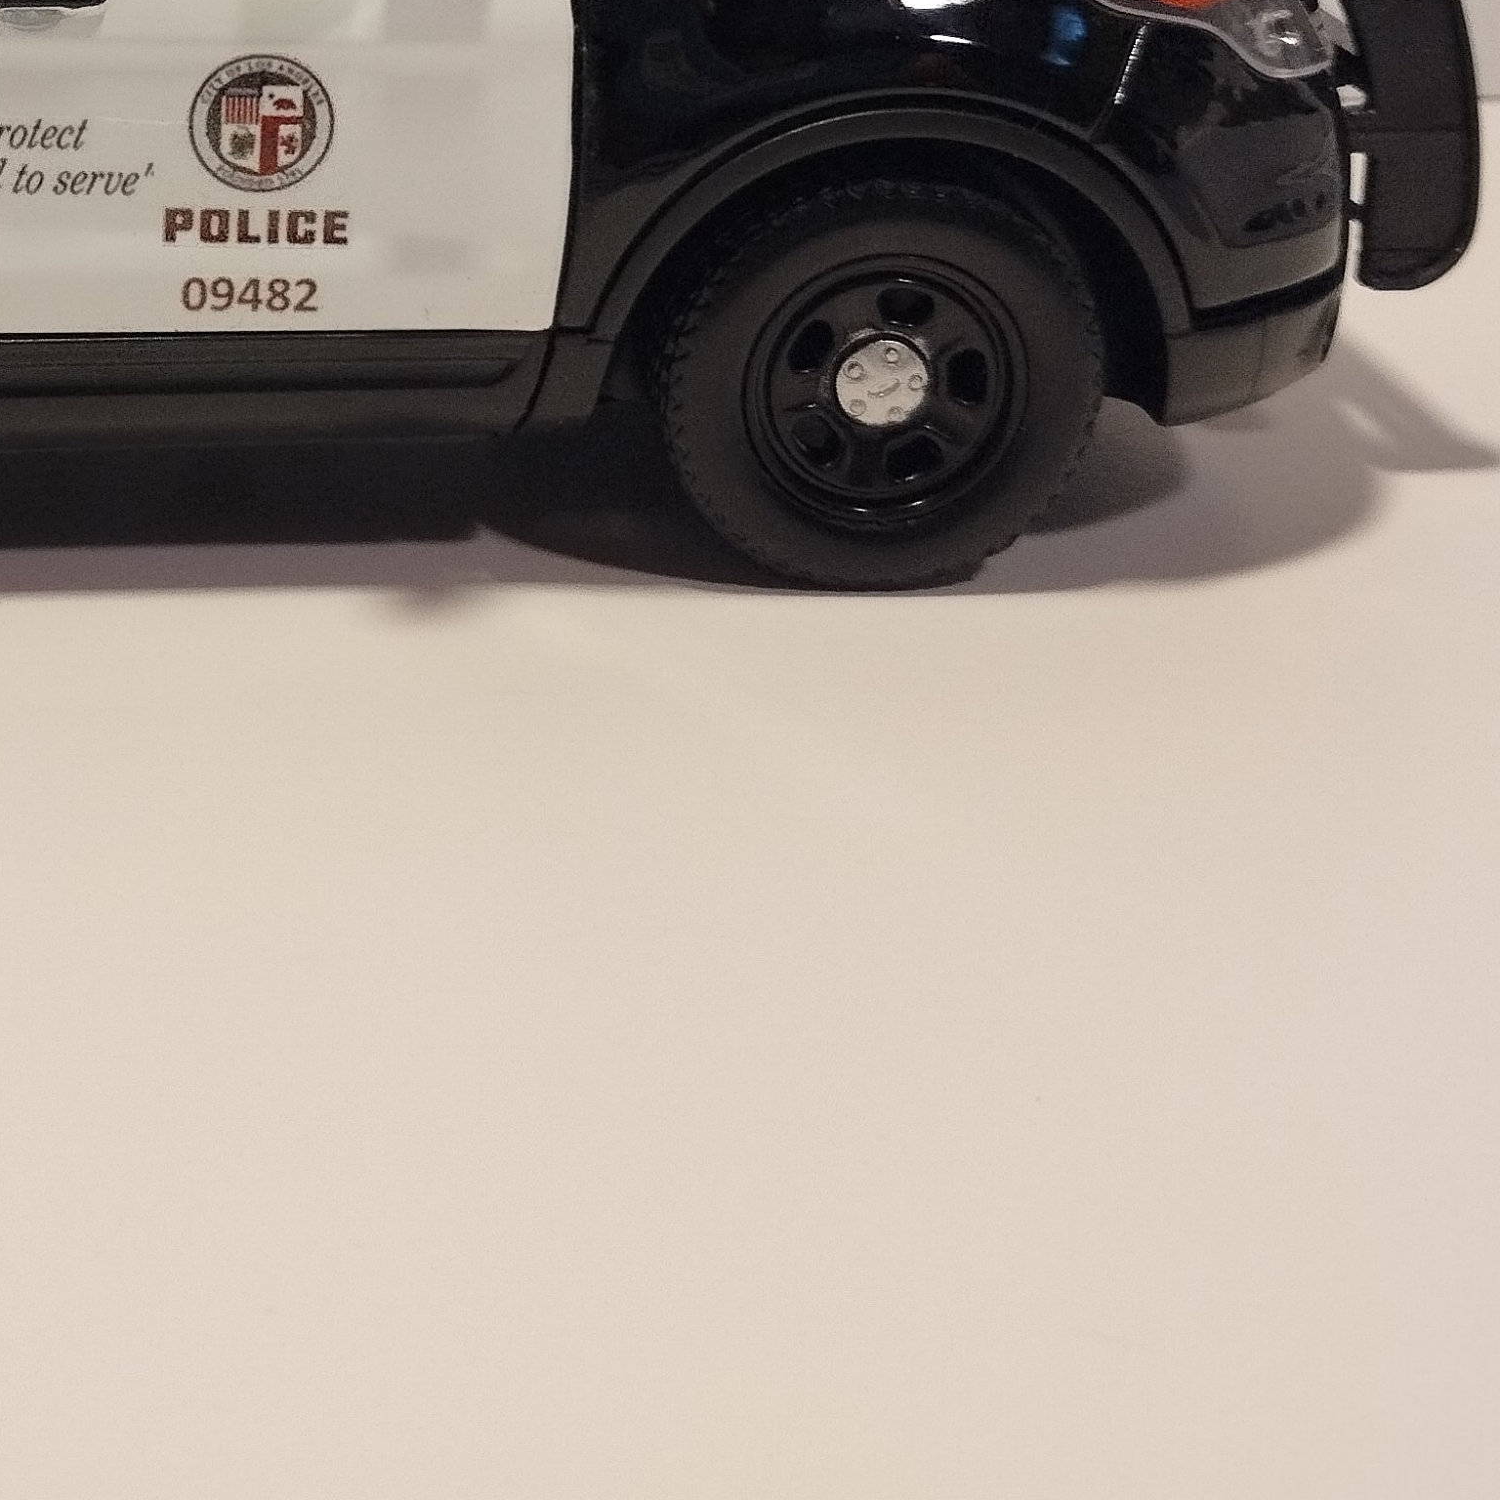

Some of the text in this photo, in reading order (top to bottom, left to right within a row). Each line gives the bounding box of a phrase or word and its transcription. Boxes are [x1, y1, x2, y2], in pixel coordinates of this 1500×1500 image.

[12, 163, 45, 195] to
[164, 207, 349, 245] POLICE
[181, 276, 319, 313] 09482
